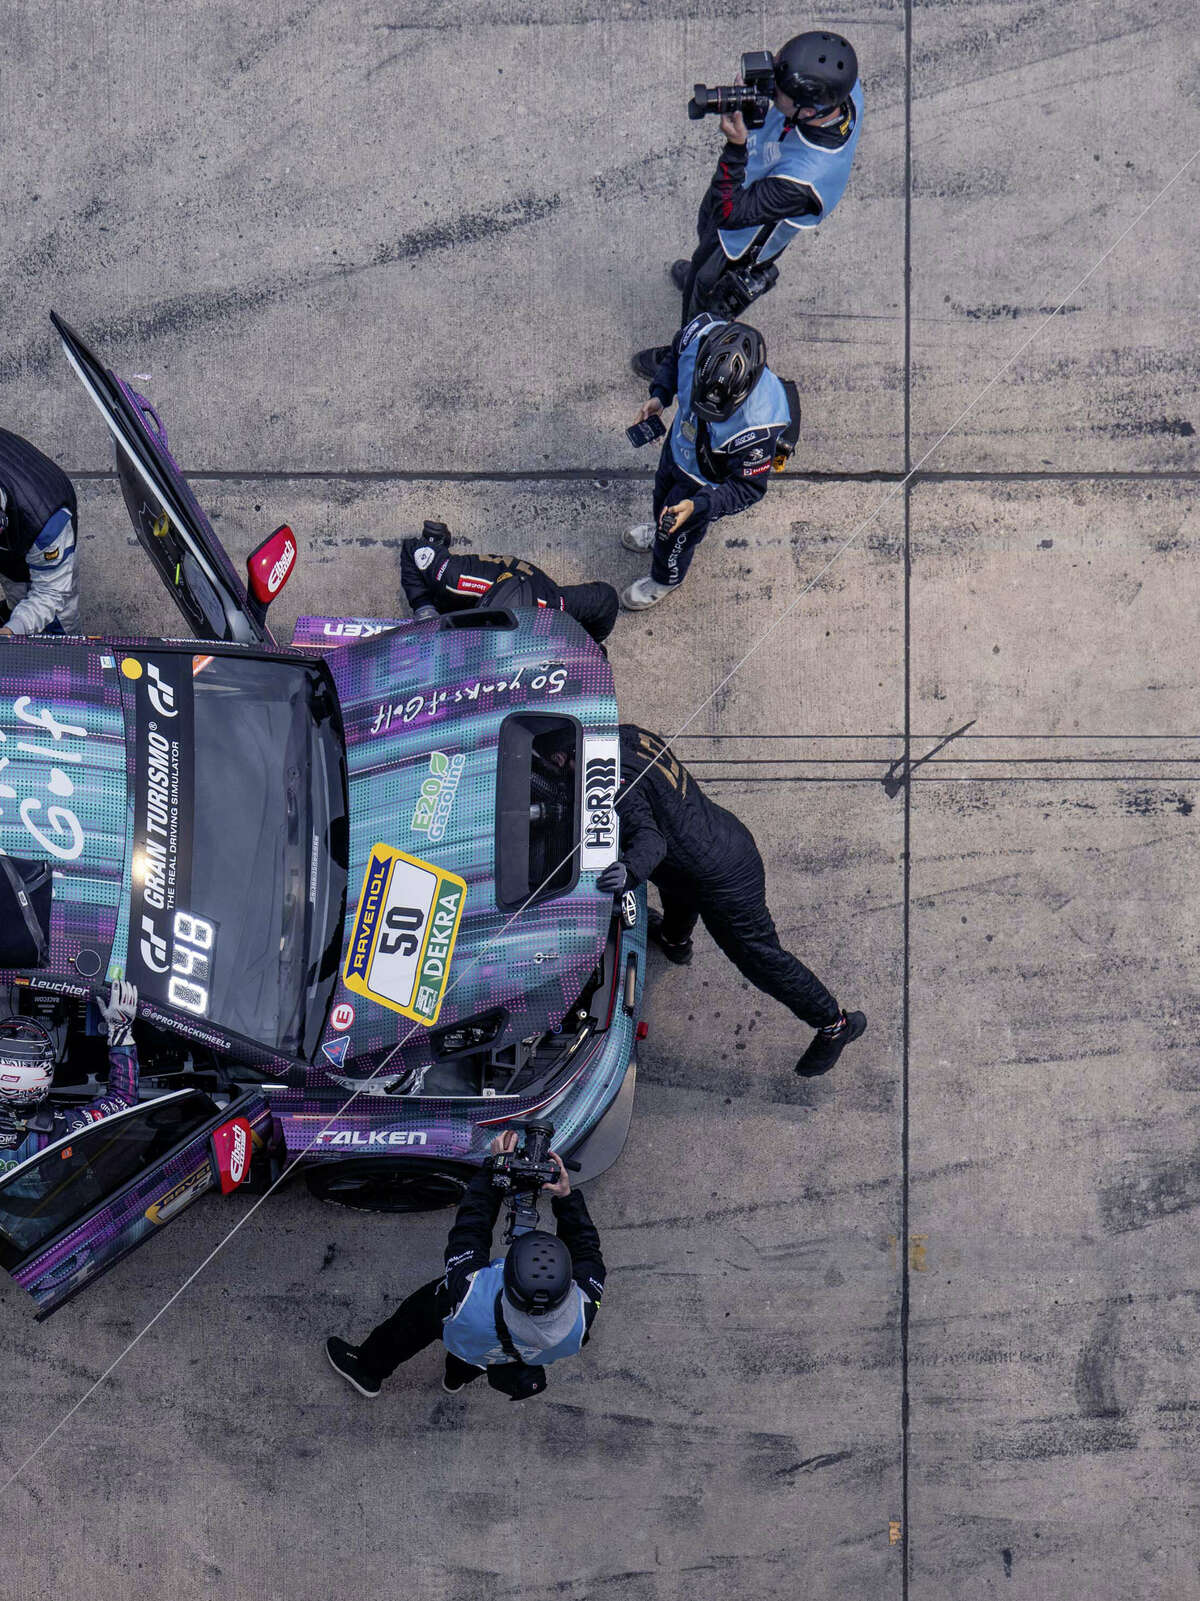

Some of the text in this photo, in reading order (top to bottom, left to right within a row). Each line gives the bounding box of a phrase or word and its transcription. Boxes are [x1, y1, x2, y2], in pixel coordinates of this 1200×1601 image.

[268, 540, 295, 593] Eibach
[323, 623, 398, 638] KEN
[370, 696, 425, 735] Golf
[411, 777, 442, 831] E20
[427, 753, 466, 841] Gasoline
[585, 787, 615, 850] H&R
[166, 741, 180, 911] THE REAL DRIVING SIMULATOR
[143, 838, 168, 910] GRAN
[353, 866, 385, 969] RAVENOL
[378, 906, 425, 957] 50
[423, 892, 461, 977] DEKRA
[29, 976, 90, 997] Leuchter
[230, 1124, 247, 1183] Eibach
[315, 1130, 428, 1146] FALKEN
